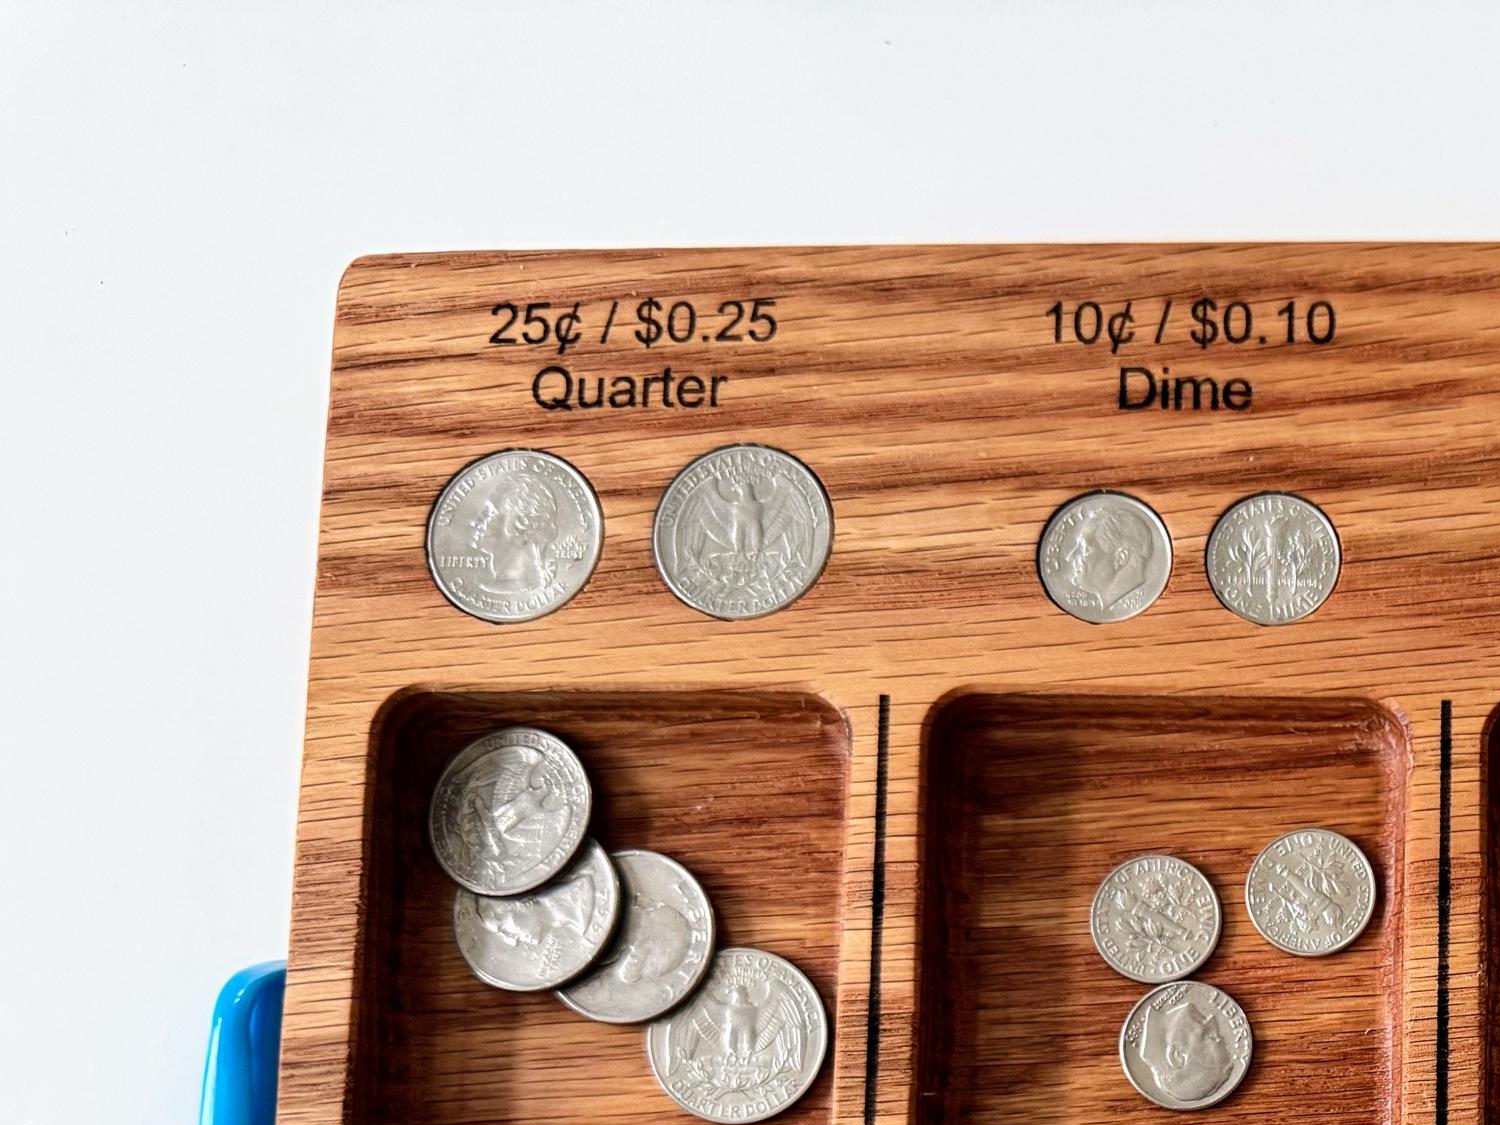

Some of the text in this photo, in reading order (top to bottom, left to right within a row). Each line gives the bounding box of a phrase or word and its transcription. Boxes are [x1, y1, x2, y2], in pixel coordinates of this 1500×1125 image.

[489, 296, 779, 355] 25¢ / $0.25
[1045, 297, 1337, 355] 10¢ / $0.10
[531, 366, 729, 411] Quarter
[1118, 367, 1254, 411] Dime
